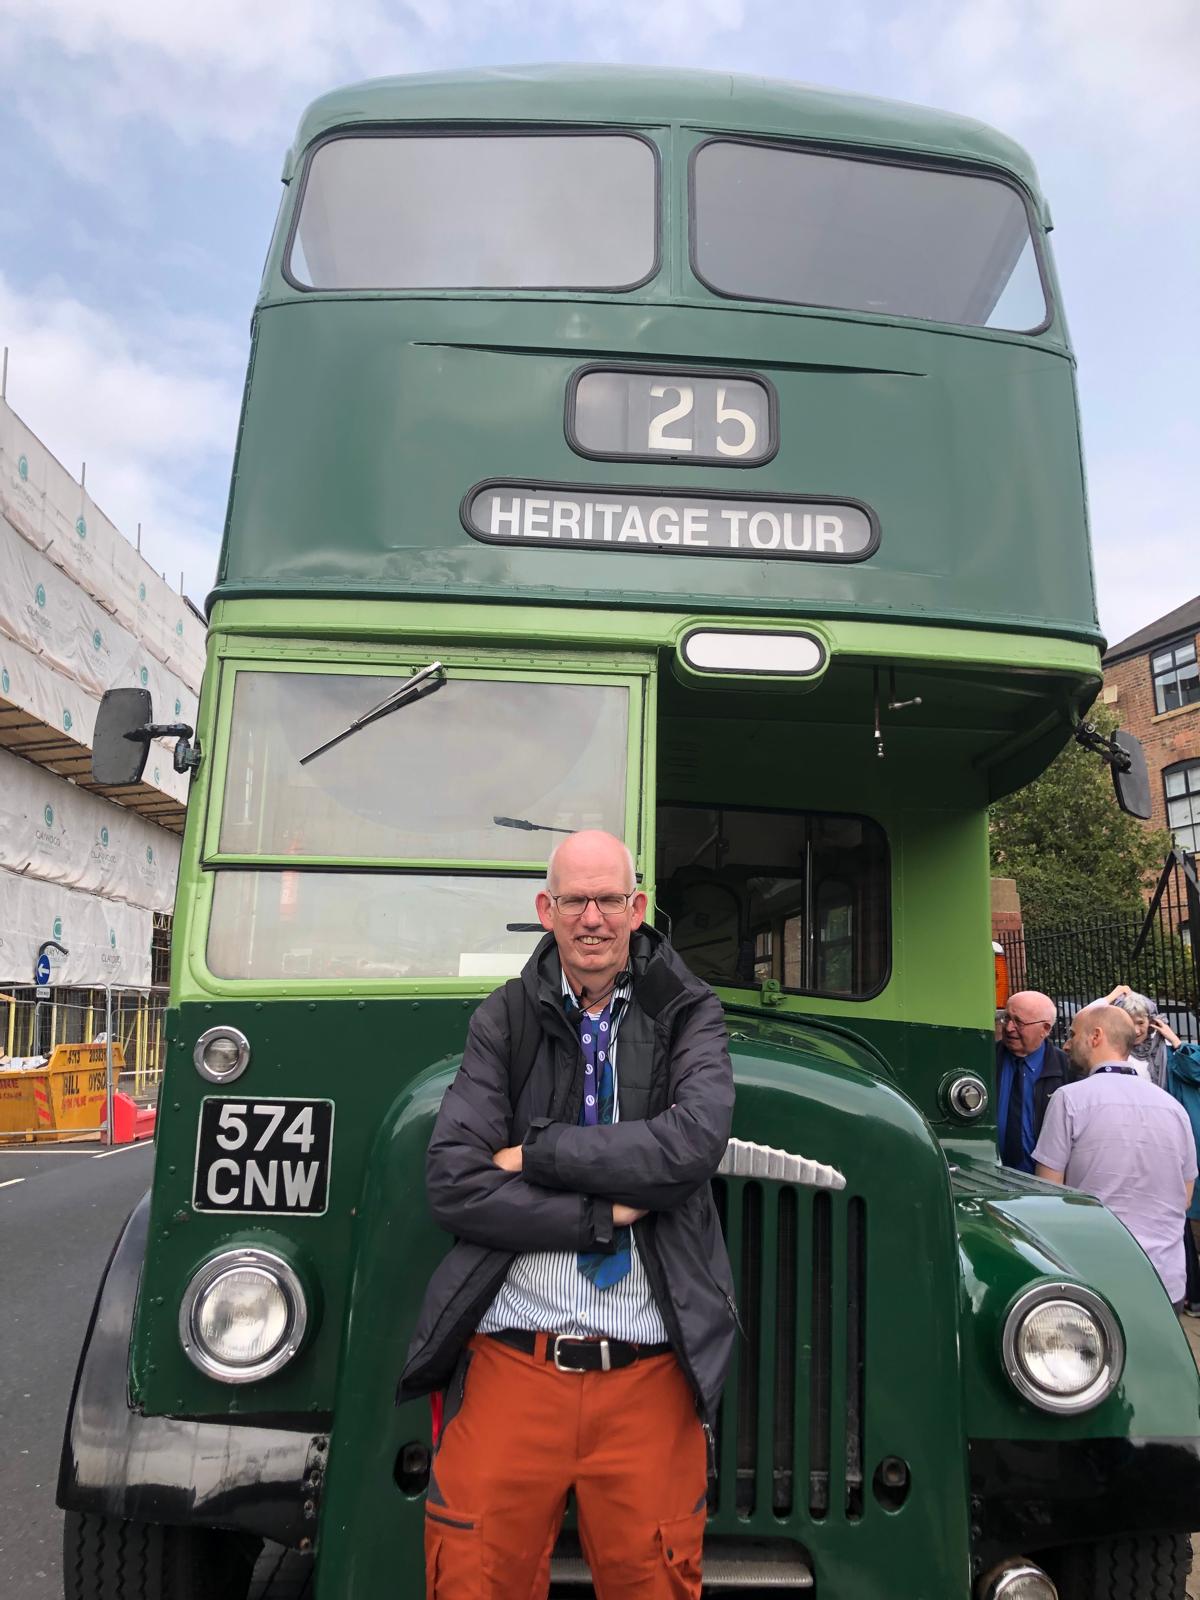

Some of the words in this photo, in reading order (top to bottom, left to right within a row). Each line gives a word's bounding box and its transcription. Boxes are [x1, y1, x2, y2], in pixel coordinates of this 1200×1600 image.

[647, 385, 757, 457] 25
[490, 497, 709, 547] HERITAGE
[720, 510, 845, 554] TOUR
[88, 1071, 108, 1092] DYSO
[216, 1104, 316, 1153] 574
[206, 1158, 320, 1207] CNW
